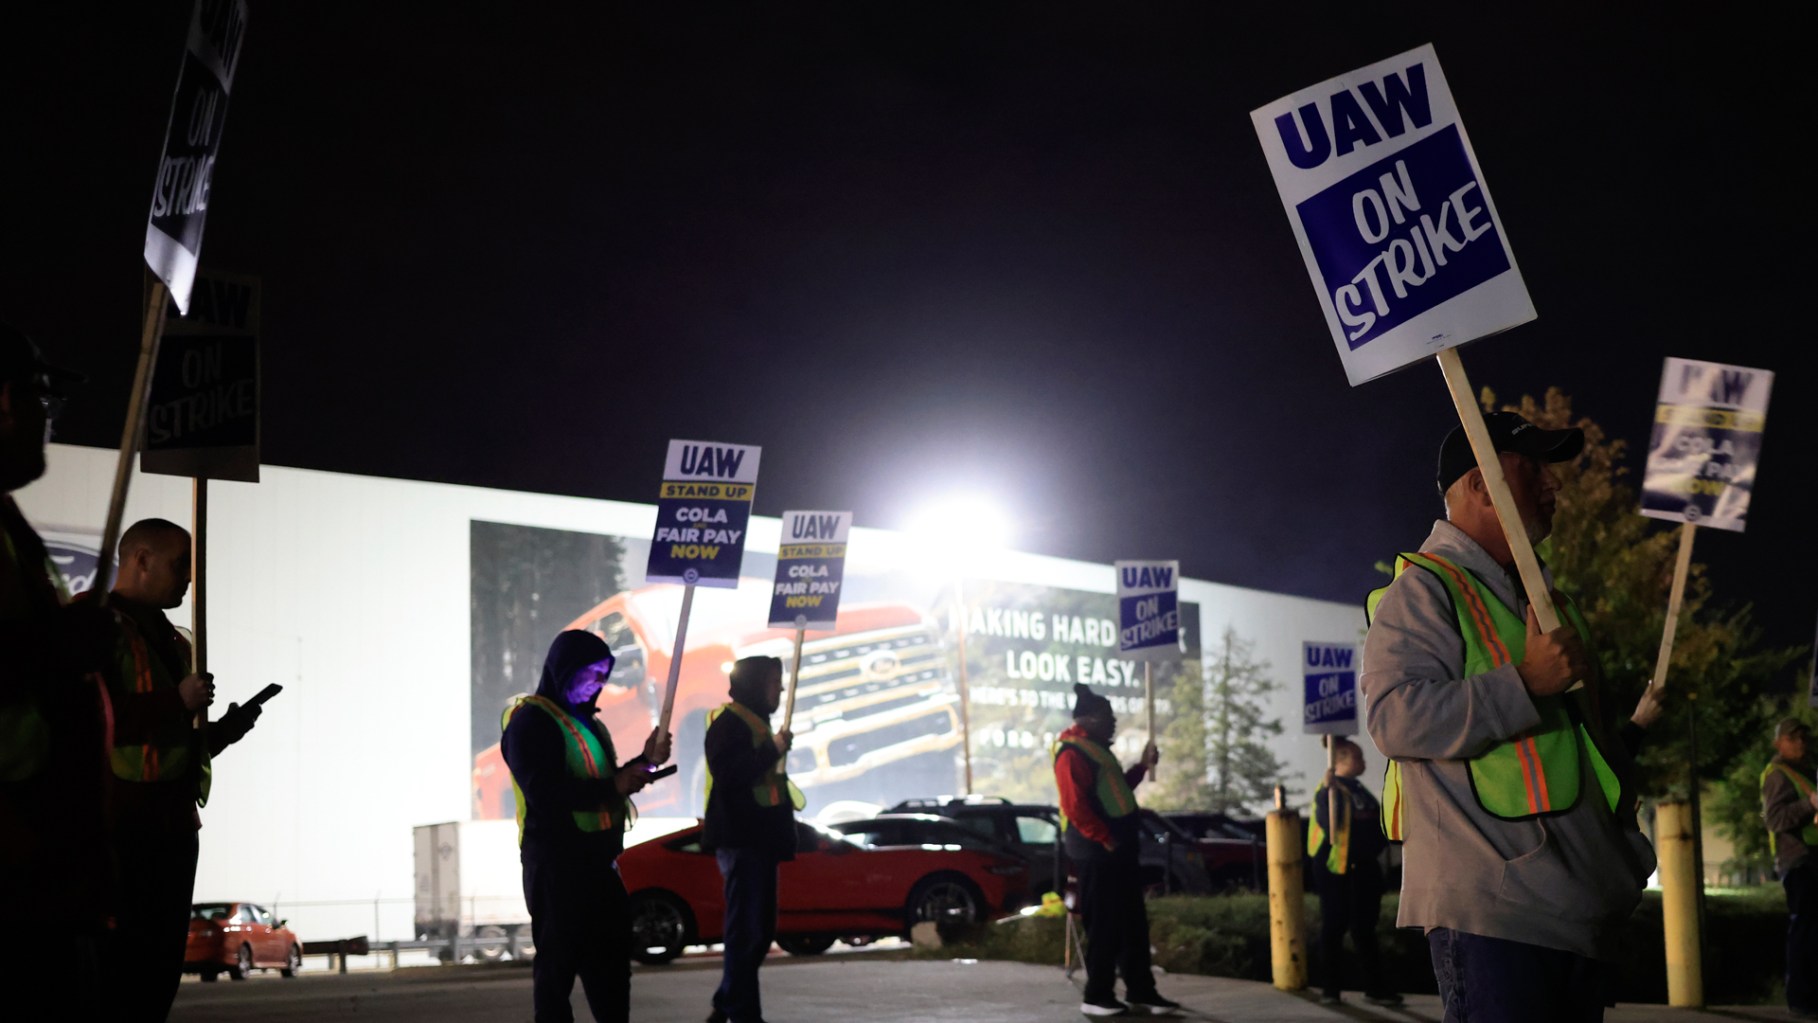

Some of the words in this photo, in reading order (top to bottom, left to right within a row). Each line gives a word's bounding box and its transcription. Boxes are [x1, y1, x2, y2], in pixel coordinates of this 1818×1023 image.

[188, 87, 219, 148] ON
[1274, 62, 1433, 169] UAW
[153, 153, 214, 217] STRIKE
[1352, 159, 1421, 245] ON
[1335, 180, 1492, 341] STRIKE
[168, 276, 252, 329] AW
[181, 341, 223, 389] ON
[150, 378, 254, 445] STRIKE
[680, 445, 745, 478] UAW
[666, 485, 720, 497] STAND
[725, 487, 747, 498] UP
[675, 507, 728, 523] COLA
[792, 514, 841, 539] UAW
[656, 528, 700, 543] FAIR
[703, 529, 742, 544] PAY
[671, 544, 720, 559] NOW
[788, 565, 829, 577] COLA
[1122, 566, 1173, 588] UAW
[775, 582, 807, 595] FAIR
[809, 582, 840, 595] PAY
[786, 595, 824, 608] NOW
[1136, 595, 1159, 621] ON
[1052, 614, 1117, 647] HARD
[1121, 610, 1177, 649] STRIKE
[1006, 650, 1072, 683] LOOK
[1077, 656, 1140, 688] EASY.
[1307, 646, 1354, 668] UAW
[1319, 675, 1339, 698] ON
